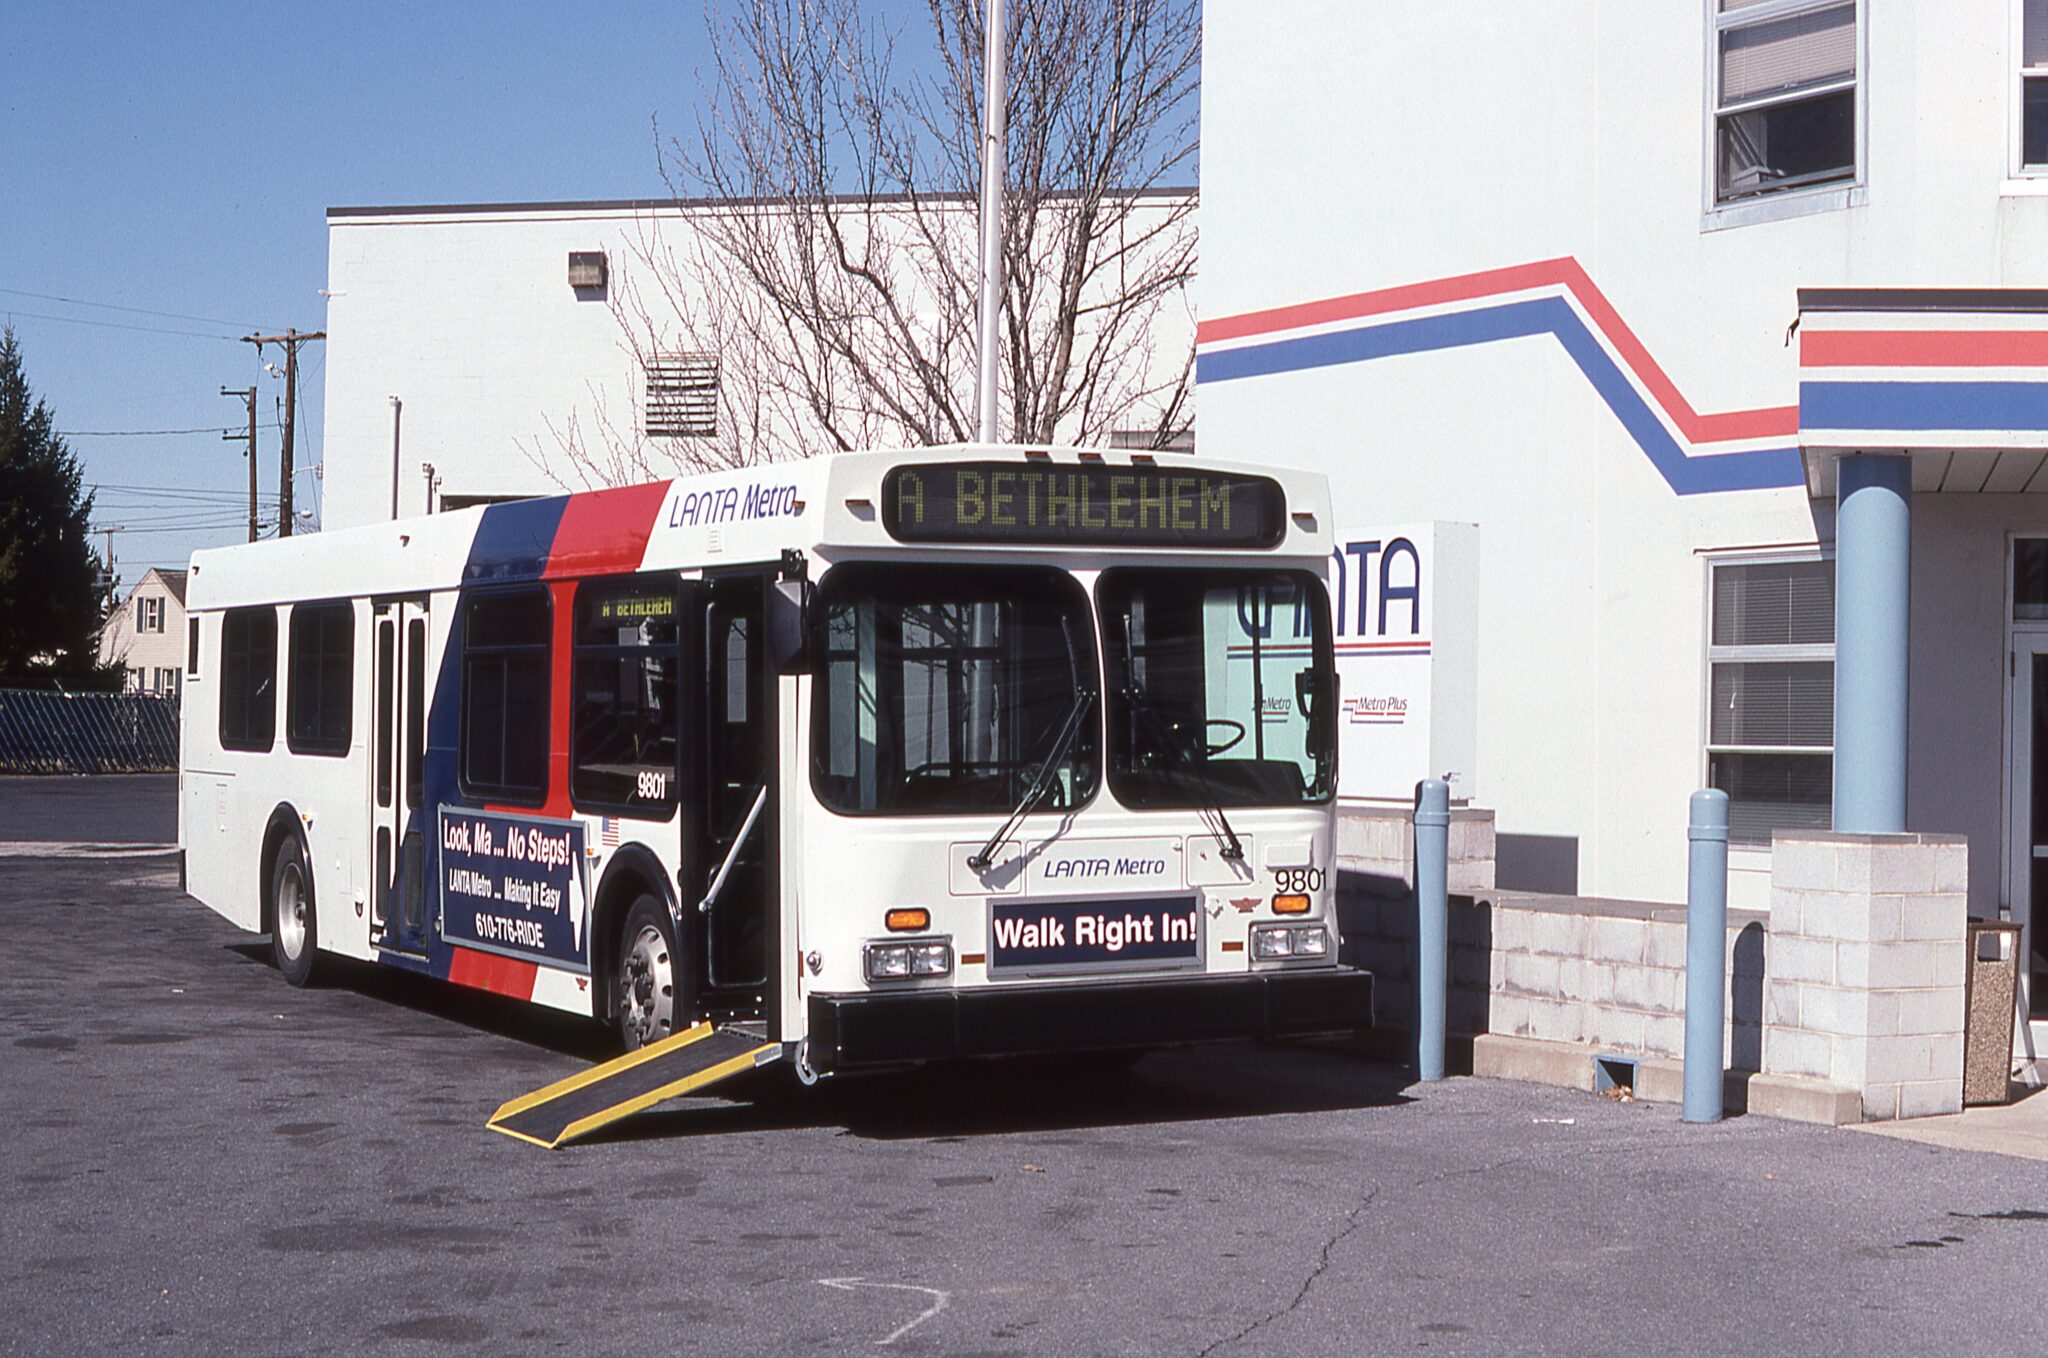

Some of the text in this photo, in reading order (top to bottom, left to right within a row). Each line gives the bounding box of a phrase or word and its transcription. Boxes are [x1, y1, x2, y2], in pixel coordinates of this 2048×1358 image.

[669, 483, 797, 528] LANTA Metro
[898, 470, 1231, 530] A BETHLEHEM
[602, 598, 672, 617] A BETHLEHEM
[1358, 697, 1407, 710] Metro Plus
[637, 771, 665, 800] 9801
[443, 818, 472, 857] Look,
[474, 822, 492, 854] Ma
[507, 826, 526, 860] No
[527, 828, 570, 872] Steps!
[1044, 858, 1165, 878] LANTA Metro
[1275, 867, 1327, 893] 9801
[471, 872, 492, 898] Metro
[504, 876, 532, 911] Making
[532, 880, 539, 906] It
[540, 881, 561, 915] Easy
[475, 912, 545, 949] 610-776-RIDE
[994, 911, 1197, 951] Walk Right In!
